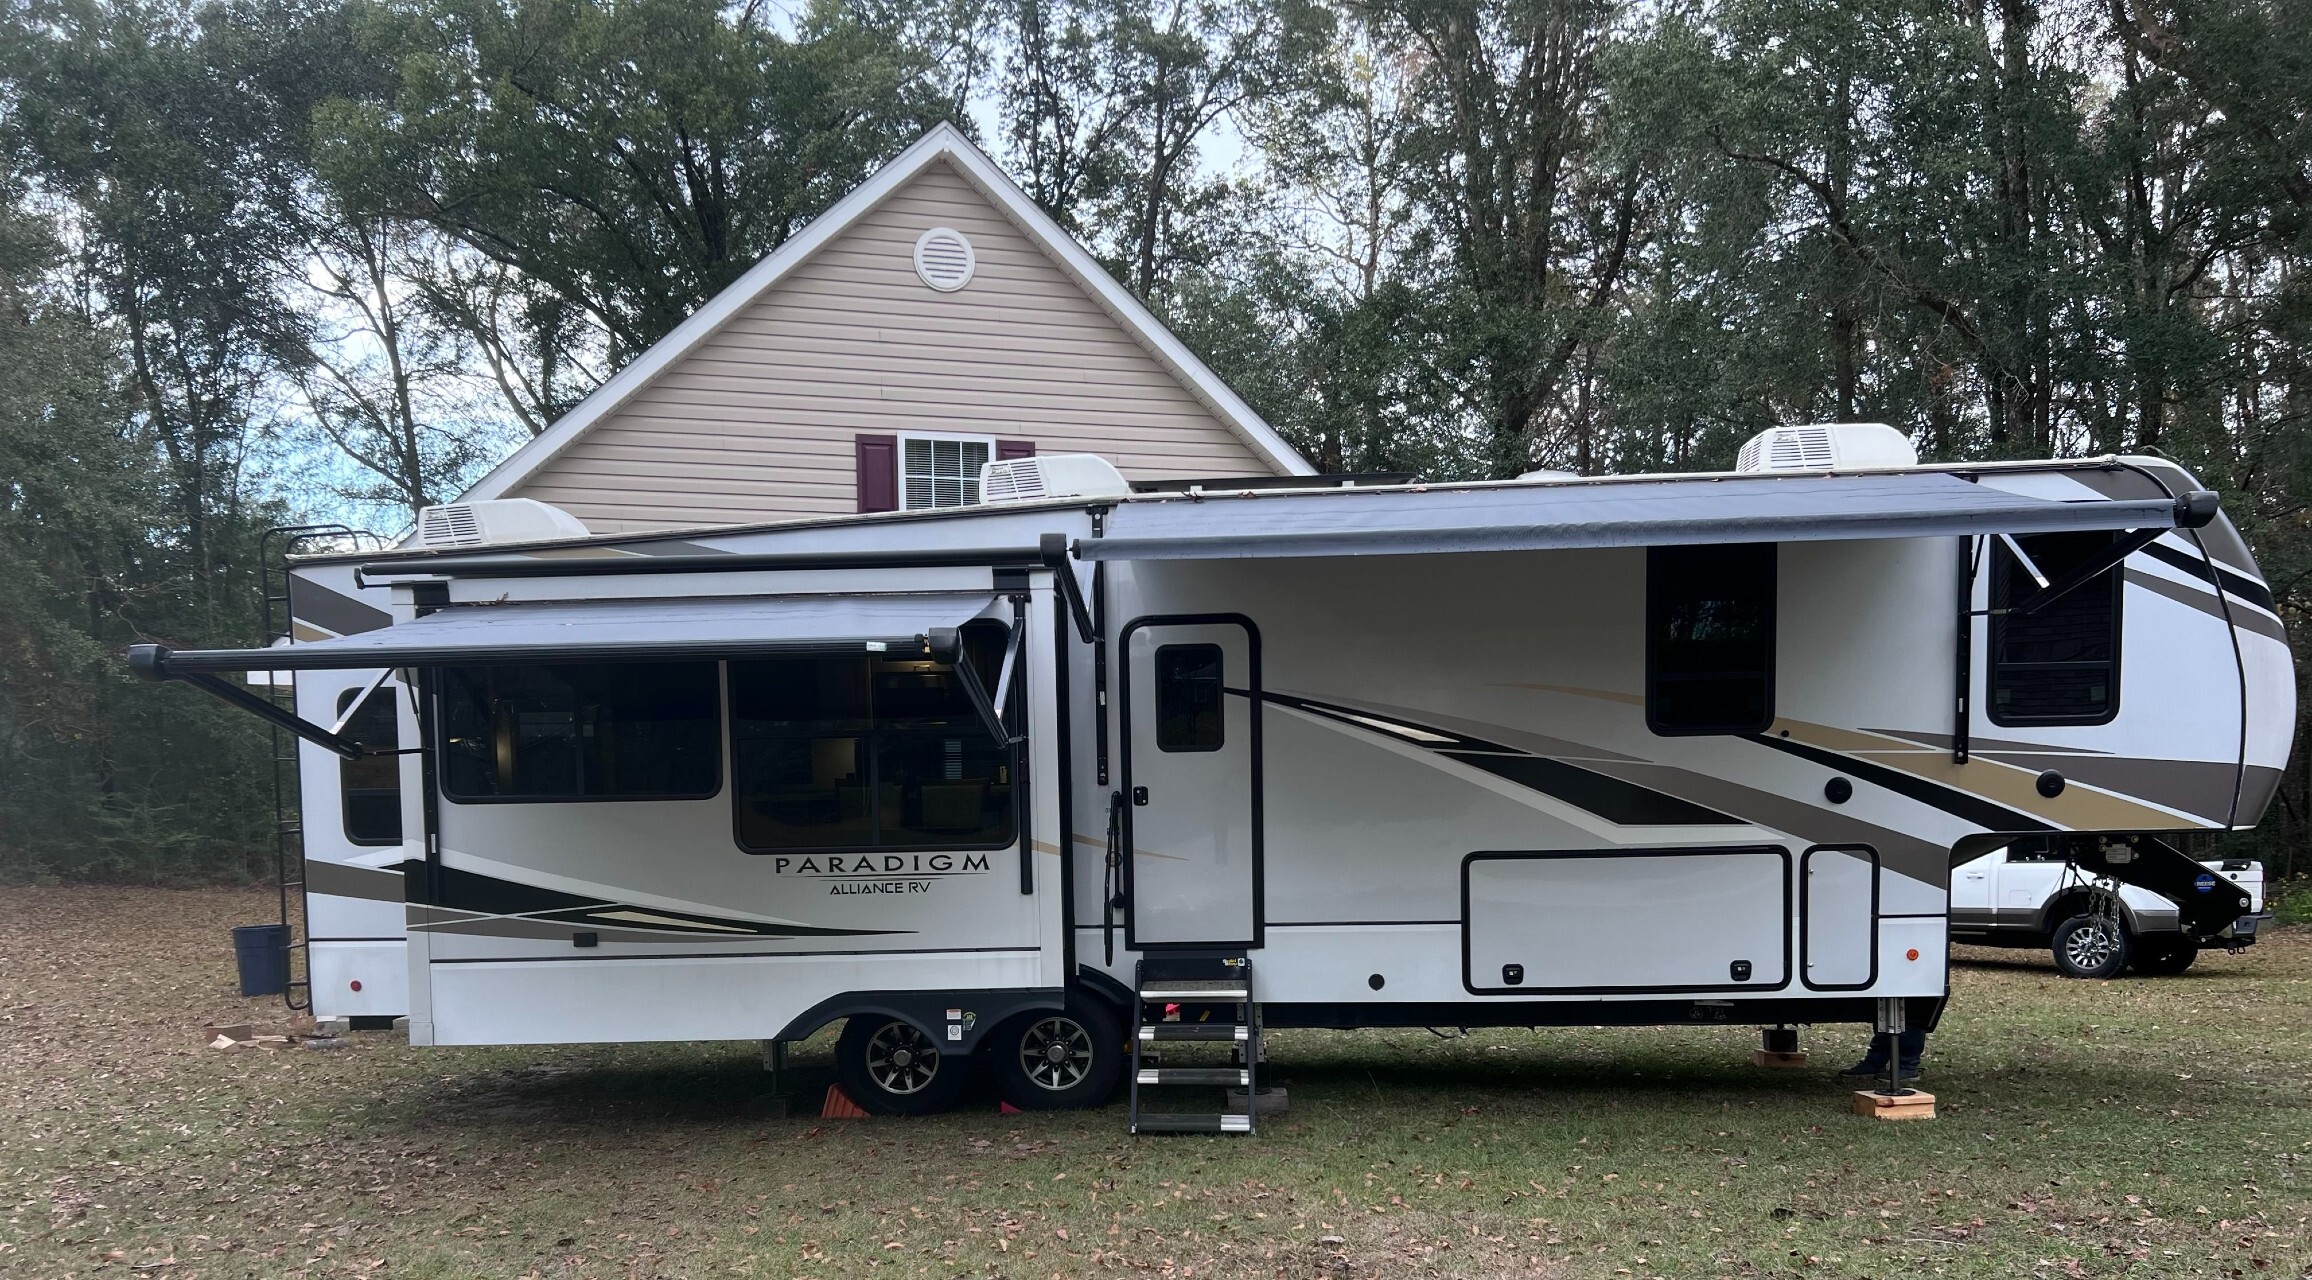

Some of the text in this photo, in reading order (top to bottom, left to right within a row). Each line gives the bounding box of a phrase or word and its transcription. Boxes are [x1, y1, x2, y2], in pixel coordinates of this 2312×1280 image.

[775, 853, 990, 874] PARADIGM
[830, 881, 931, 895] ALLIANCE RV
